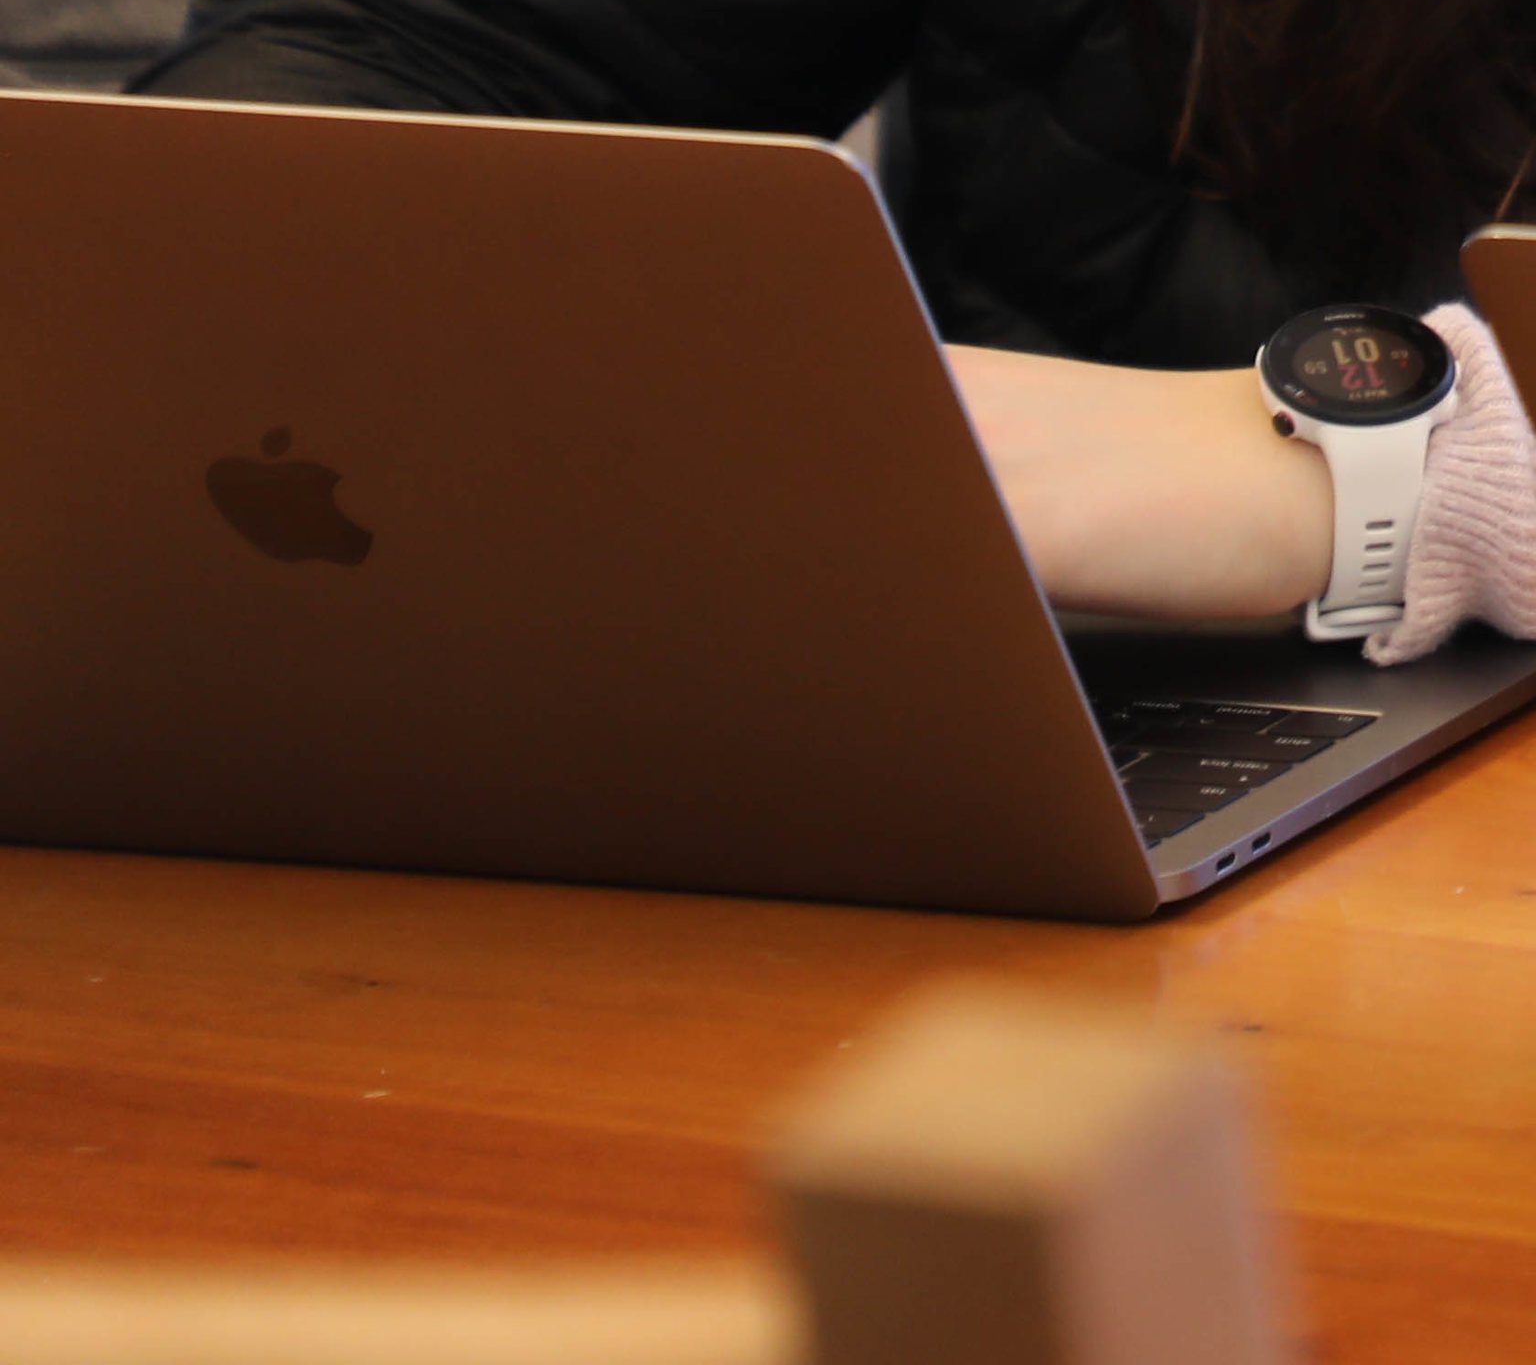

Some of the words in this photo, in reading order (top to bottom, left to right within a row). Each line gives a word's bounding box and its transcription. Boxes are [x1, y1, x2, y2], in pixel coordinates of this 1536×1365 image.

[1331, 337, 1381, 365] 01
[1339, 363, 1385, 388] 12
[1273, 735, 1312, 746] shift
